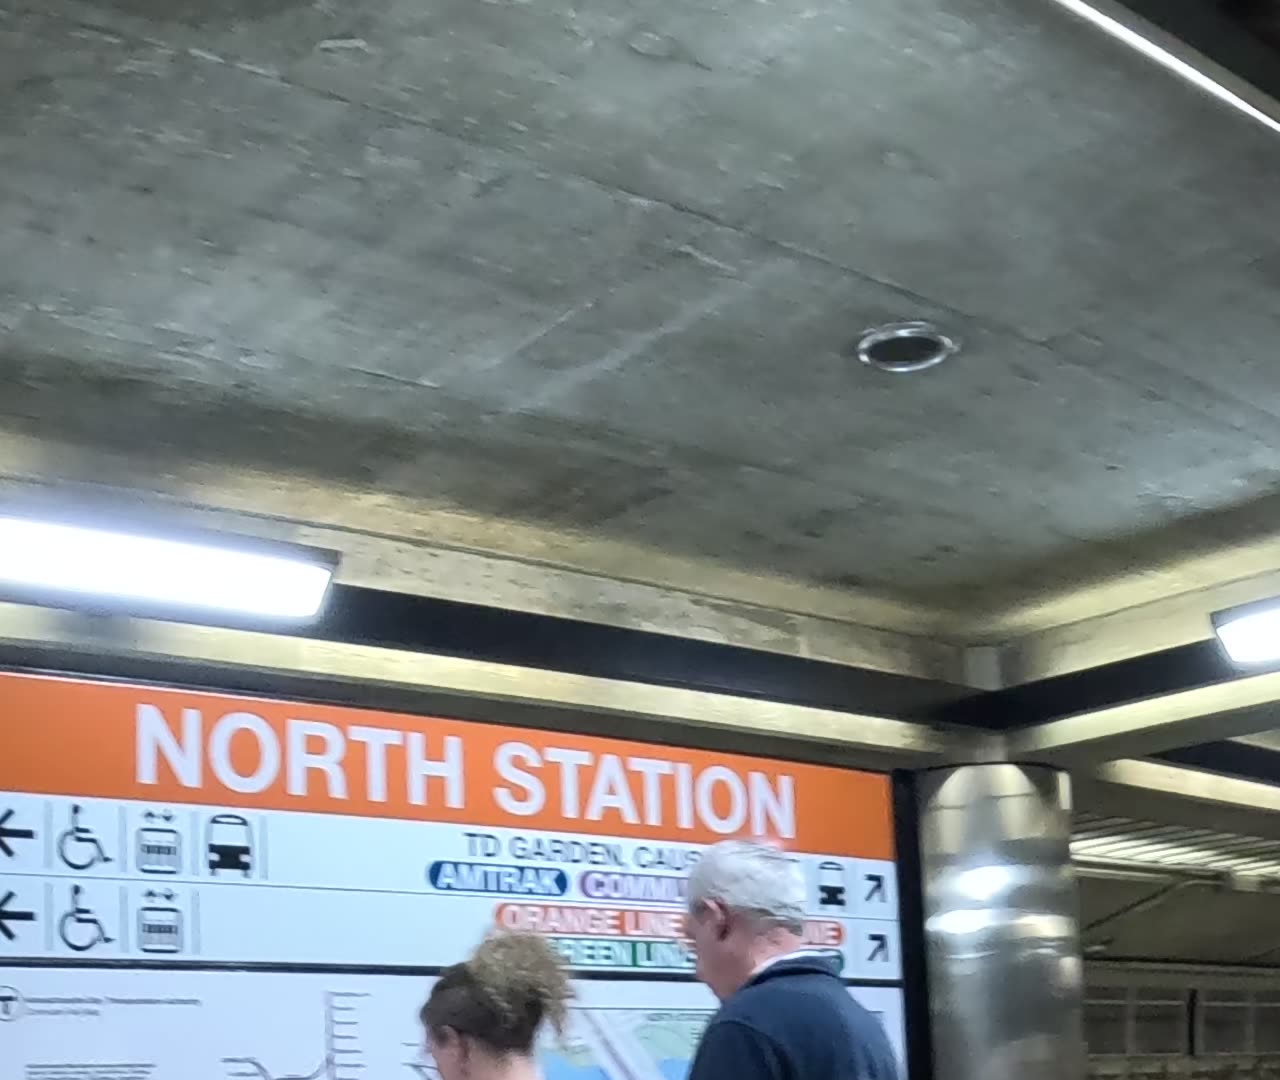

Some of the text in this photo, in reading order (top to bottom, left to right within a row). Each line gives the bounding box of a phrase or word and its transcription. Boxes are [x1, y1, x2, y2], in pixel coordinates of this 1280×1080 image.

[135, 702, 797, 840] NORTH STATION
[463, 832, 502, 858] TD
[435, 861, 563, 896] AMTRAK
[503, 904, 621, 935] ORANGE
